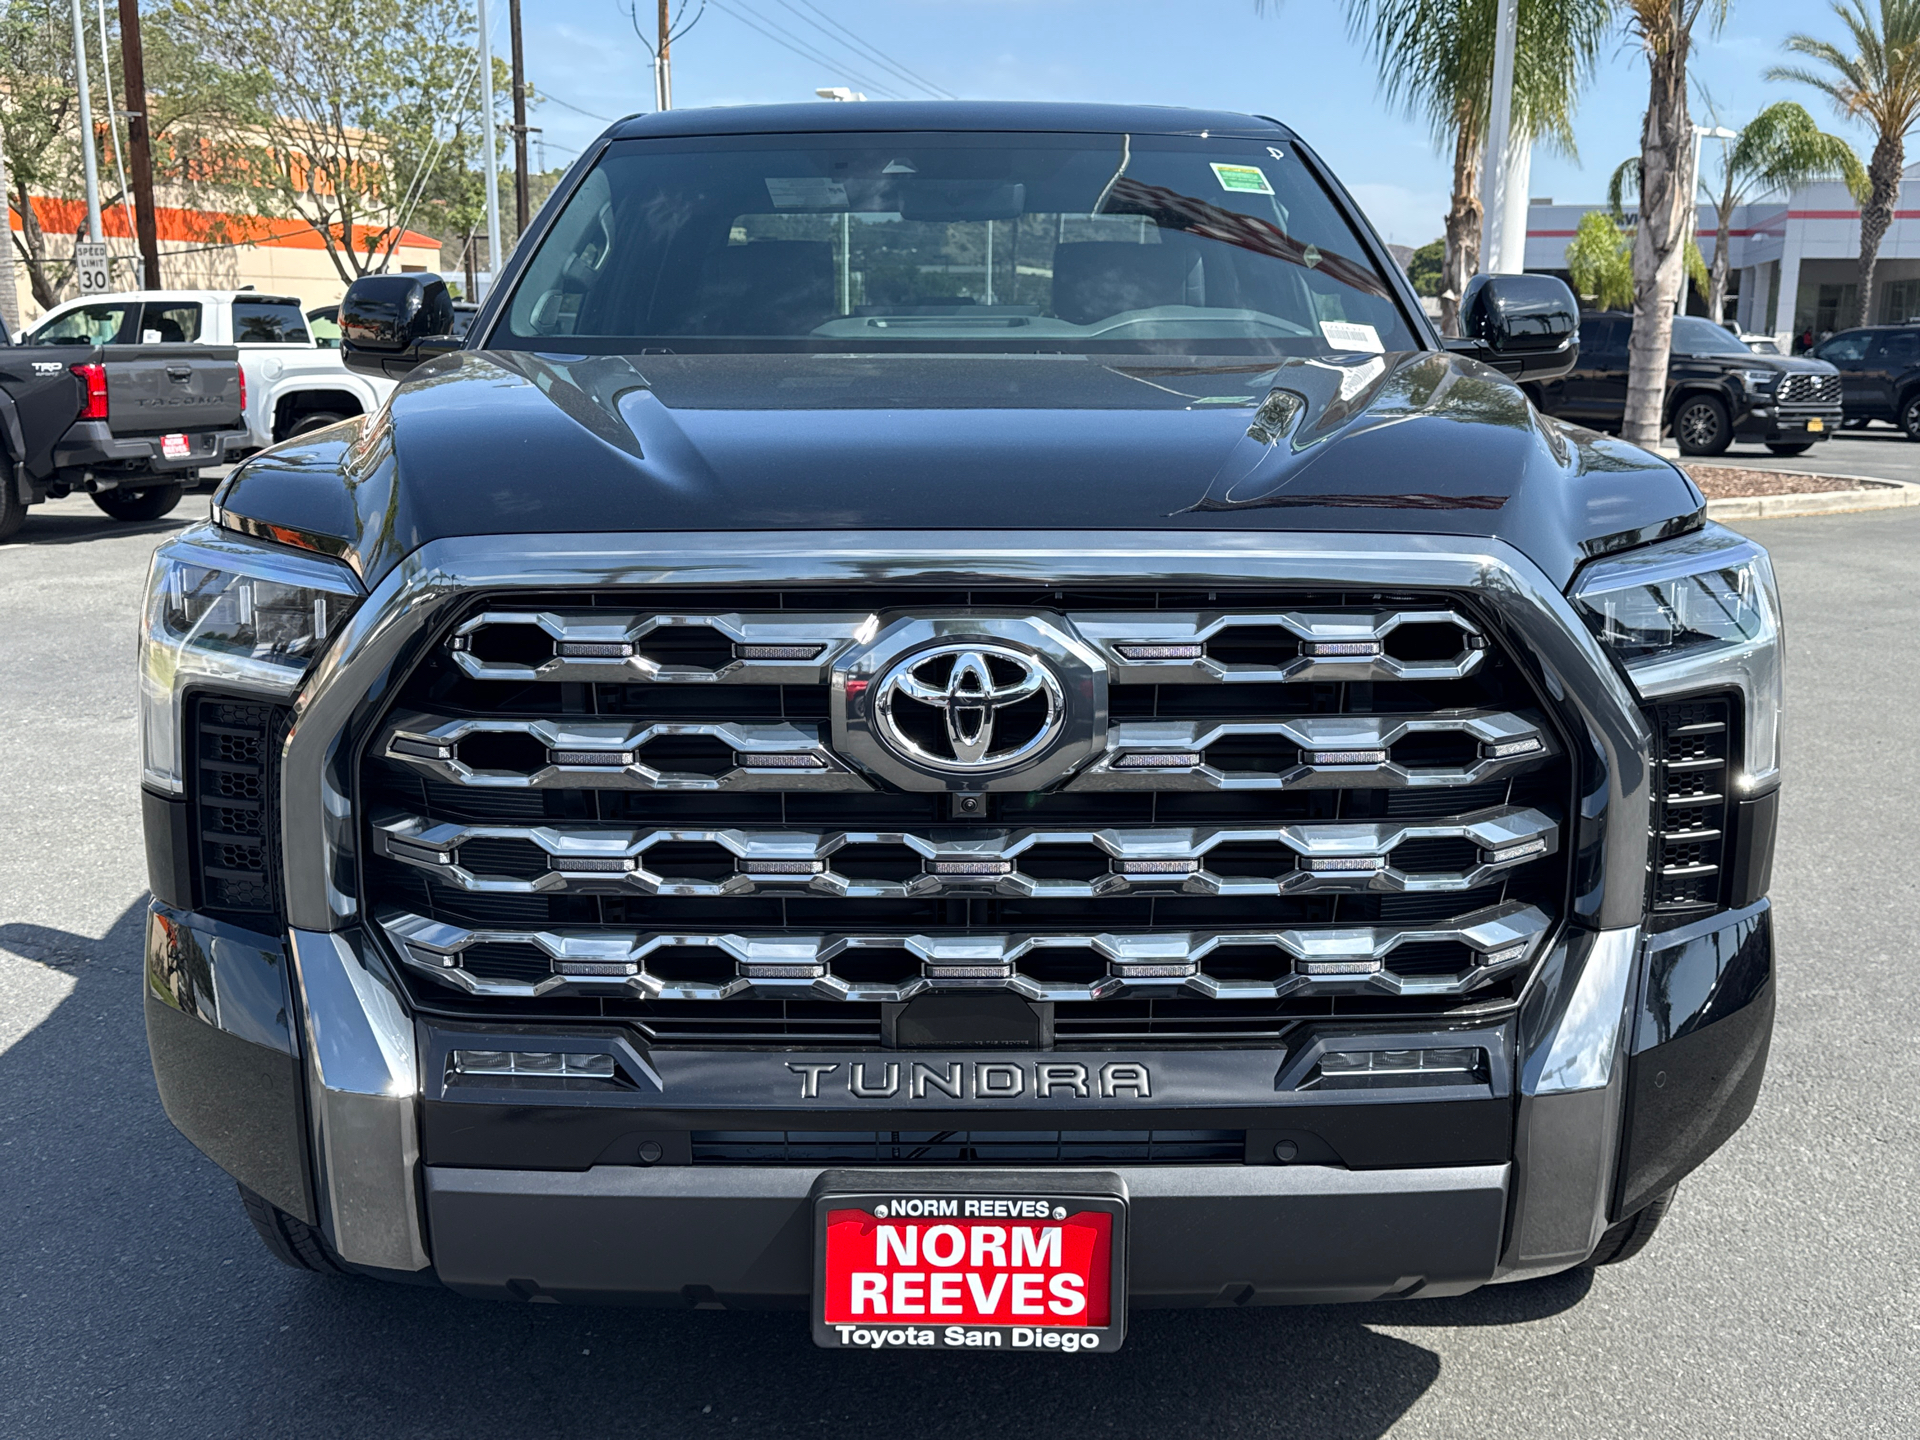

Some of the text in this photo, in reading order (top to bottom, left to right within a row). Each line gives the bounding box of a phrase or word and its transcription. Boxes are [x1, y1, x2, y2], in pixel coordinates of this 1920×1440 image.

[77, 246, 105, 256] SPEED
[81, 259, 104, 268] LIMIT
[82, 271, 106, 289] 30
[31, 362, 63, 372] TRD
[134, 395, 224, 407] TACOMA
[785, 1062, 1152, 1099] TUNDRA
[891, 1199, 1050, 1218] NORM REEVES
[876, 1224, 1063, 1267] NORM
[850, 1273, 1086, 1316] REEVES
[835, 1326, 1100, 1353] Toyota San Diego
